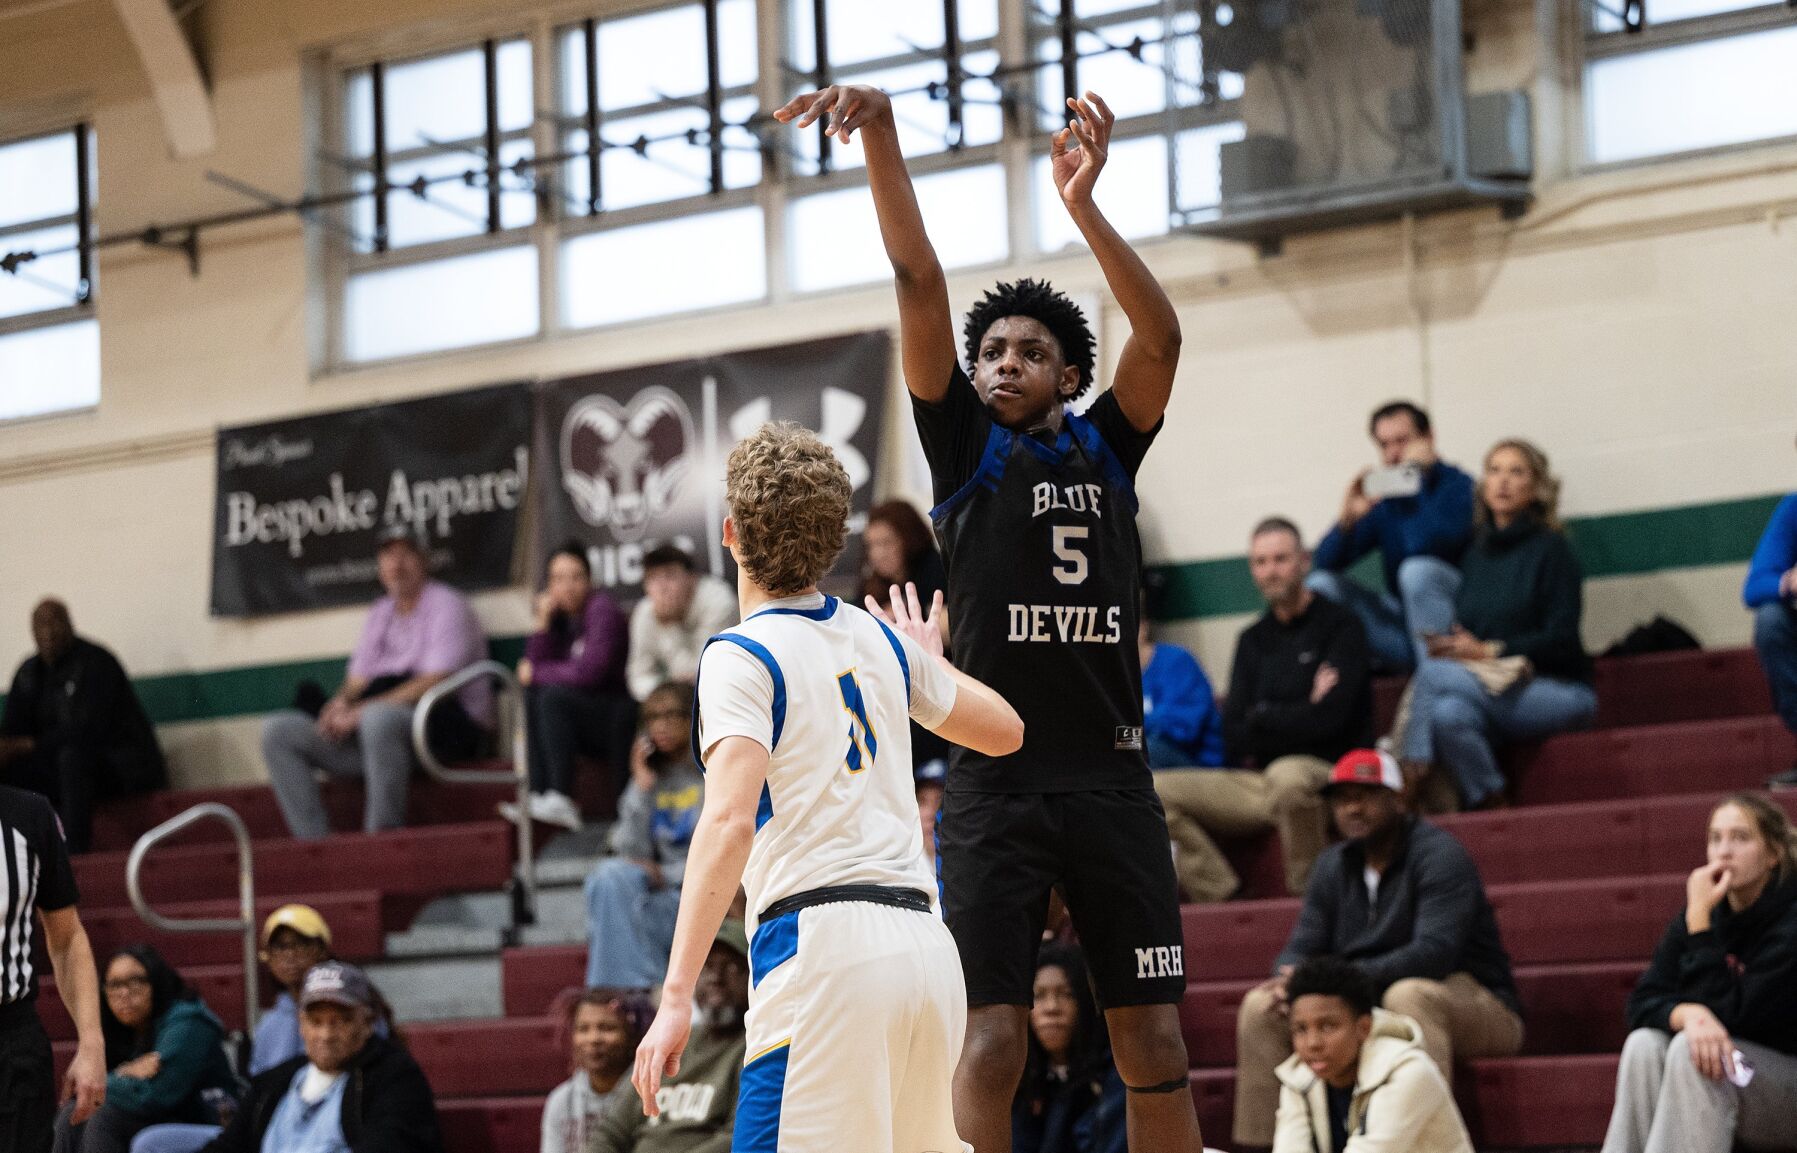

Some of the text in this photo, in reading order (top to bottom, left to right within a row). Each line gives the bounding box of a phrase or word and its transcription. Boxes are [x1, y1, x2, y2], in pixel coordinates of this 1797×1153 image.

[225, 446, 529, 558] Bespoke Apparel
[1032, 482, 1103, 518] BLUE
[1052, 525, 1089, 585] 5
[1008, 604, 1121, 644] DEVILS
[1135, 945, 1184, 979] MRH
